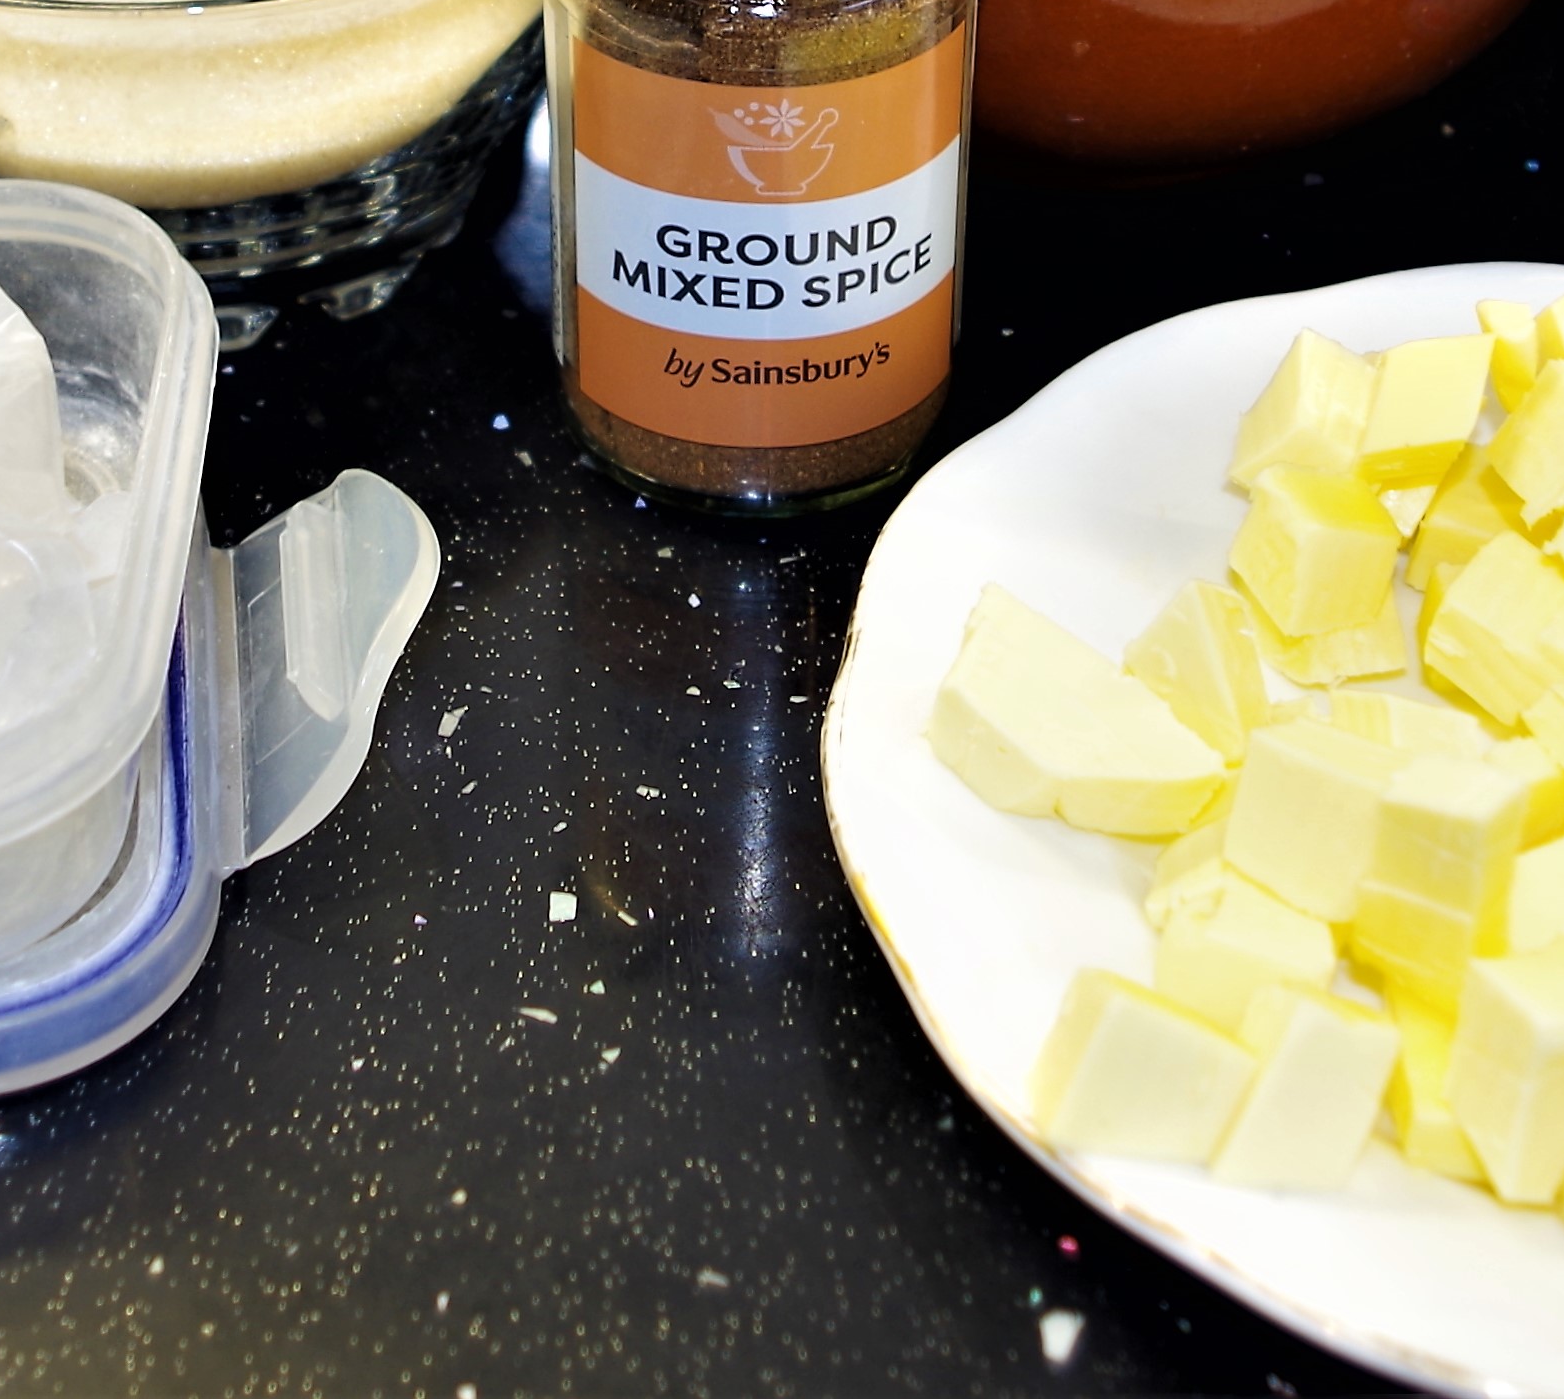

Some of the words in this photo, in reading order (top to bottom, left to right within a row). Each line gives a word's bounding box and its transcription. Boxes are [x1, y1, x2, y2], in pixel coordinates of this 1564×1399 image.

[656, 214, 898, 267] GROUND
[611, 248, 785, 311] MIXED
[800, 232, 932, 308] SPICE
[662, 347, 705, 389] by
[711, 341, 890, 385] Sainsbury's
